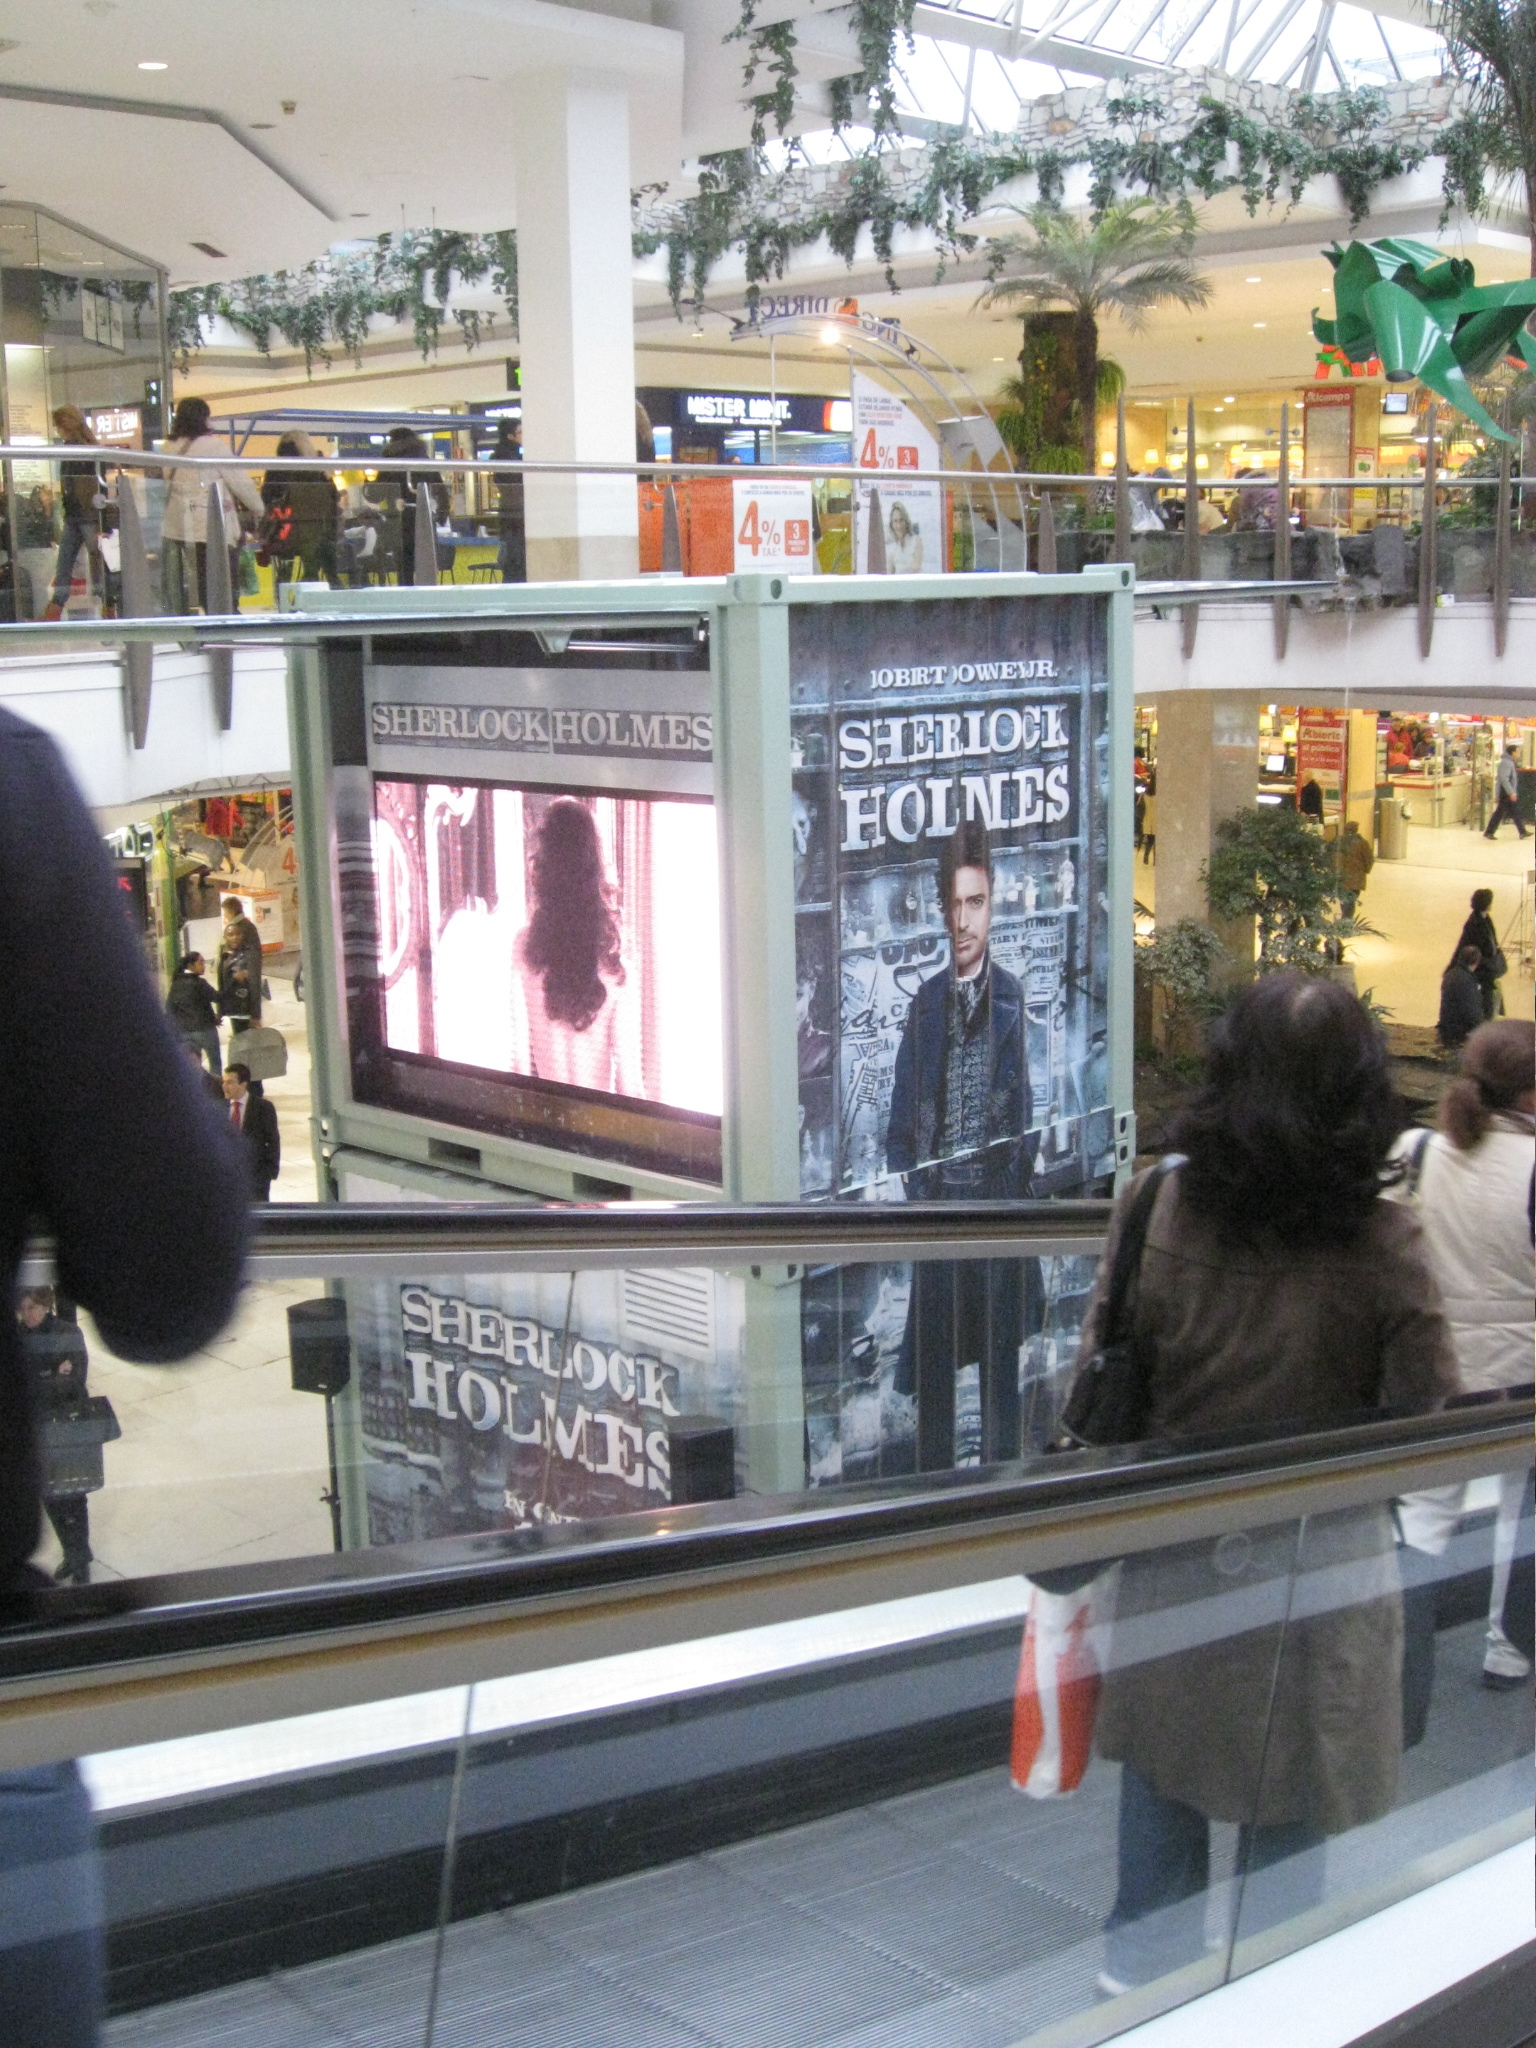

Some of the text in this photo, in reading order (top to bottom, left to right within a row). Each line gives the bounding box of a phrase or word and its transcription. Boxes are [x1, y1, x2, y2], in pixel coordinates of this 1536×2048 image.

[687, 396, 746, 417] MISTER
[738, 500, 780, 557] 4%
[792, 523, 801, 540] 3
[373, 704, 713, 751] SHERLOCK HOLMES
[838, 703, 1070, 769] SHERLOCK
[839, 764, 1070, 851] HOLMES
[400, 1287, 682, 1417] SHERLOCK
[405, 1351, 673, 1501] HOLMES
